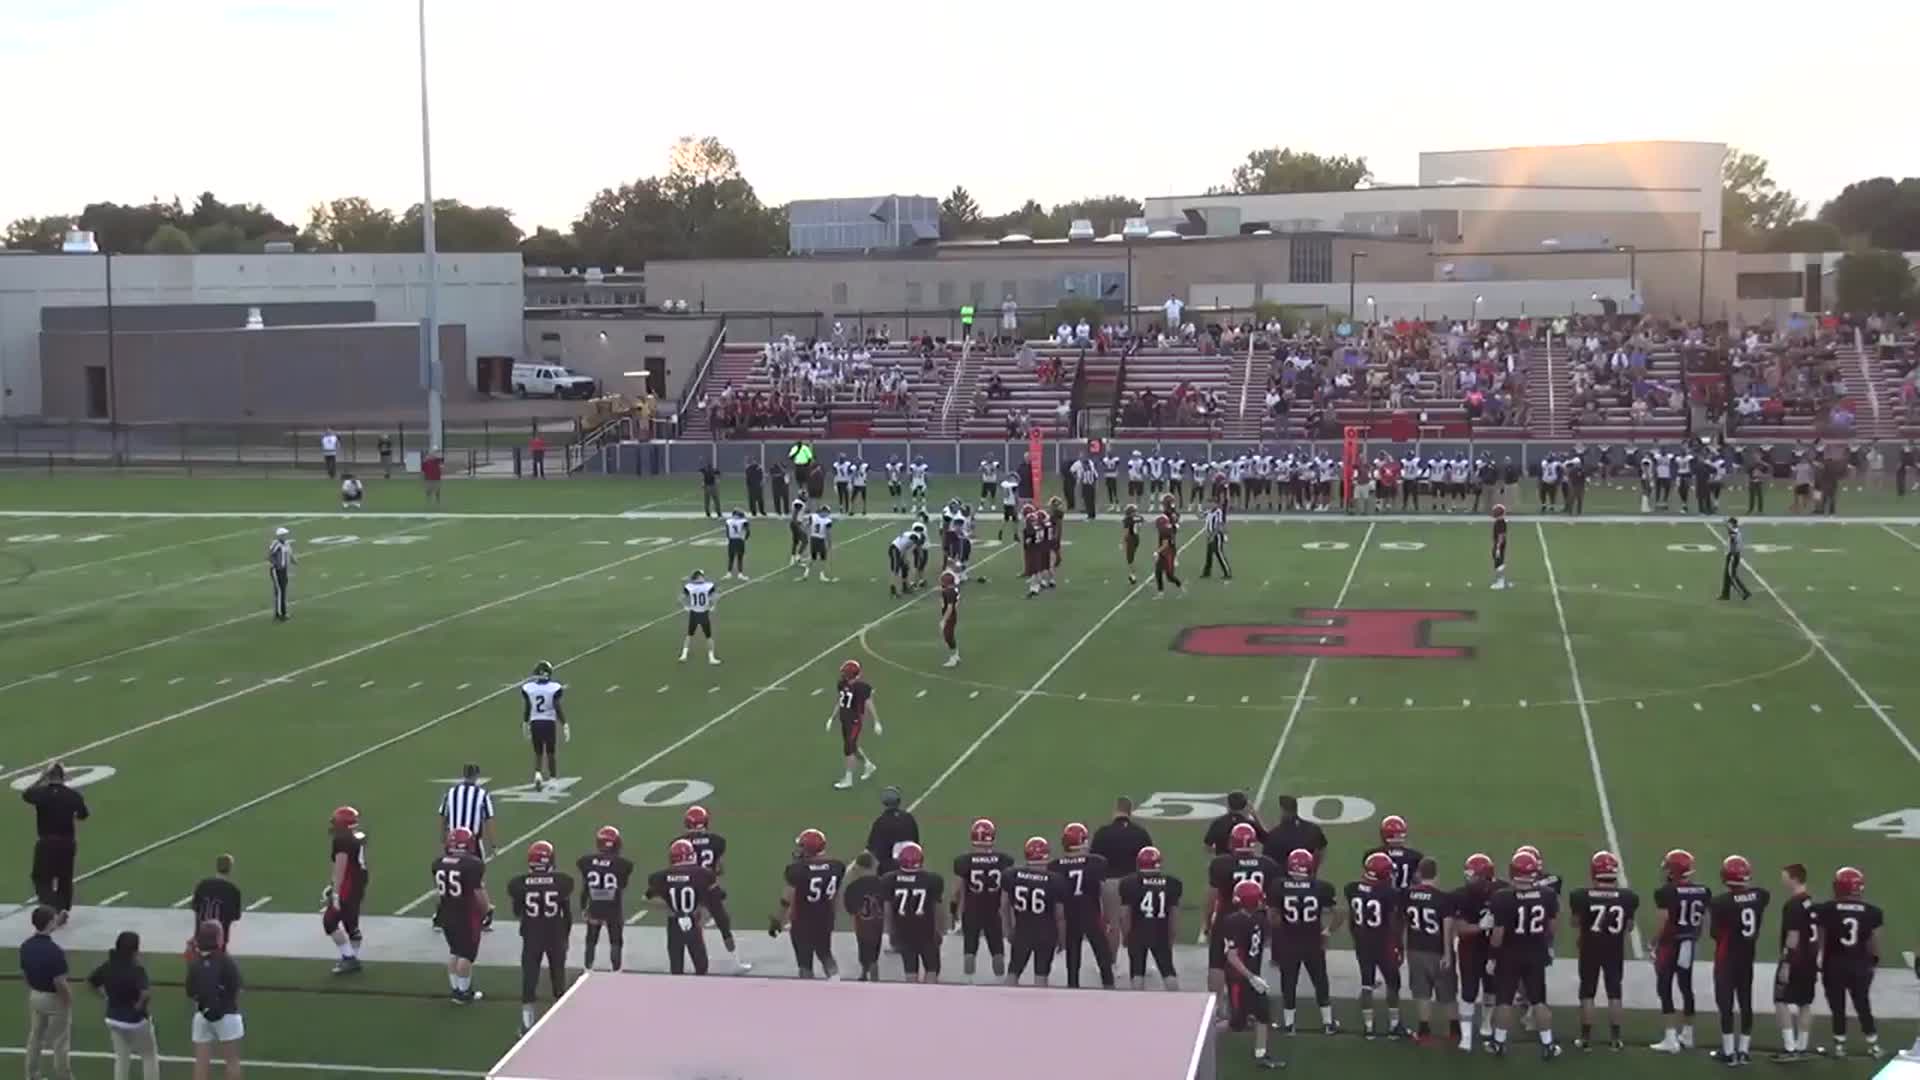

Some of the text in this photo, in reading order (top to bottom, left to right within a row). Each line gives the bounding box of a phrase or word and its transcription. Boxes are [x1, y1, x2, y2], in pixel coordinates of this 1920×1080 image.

[692, 592, 706, 606] 10
[535, 694, 546, 713] 2
[839, 691, 854, 709] 27
[436, 869, 462, 896] 65
[807, 875, 837, 902] 54
[969, 869, 1002, 893] 53
[1068, 869, 1084, 896] 7
[525, 891, 559, 917] 55
[669, 887, 696, 913] 10
[895, 888, 927, 915] 77
[1014, 885, 1046, 914] 56
[1140, 891, 1166, 918] 41
[1283, 895, 1318, 922] 52
[1677, 899, 1705, 926] 16
[1407, 906, 1440, 934] 35
[1515, 904, 1544, 934] 12
[1590, 904, 1624, 934] 73
[1741, 907, 1756, 937] 9
[1840, 917, 1859, 946] 3
